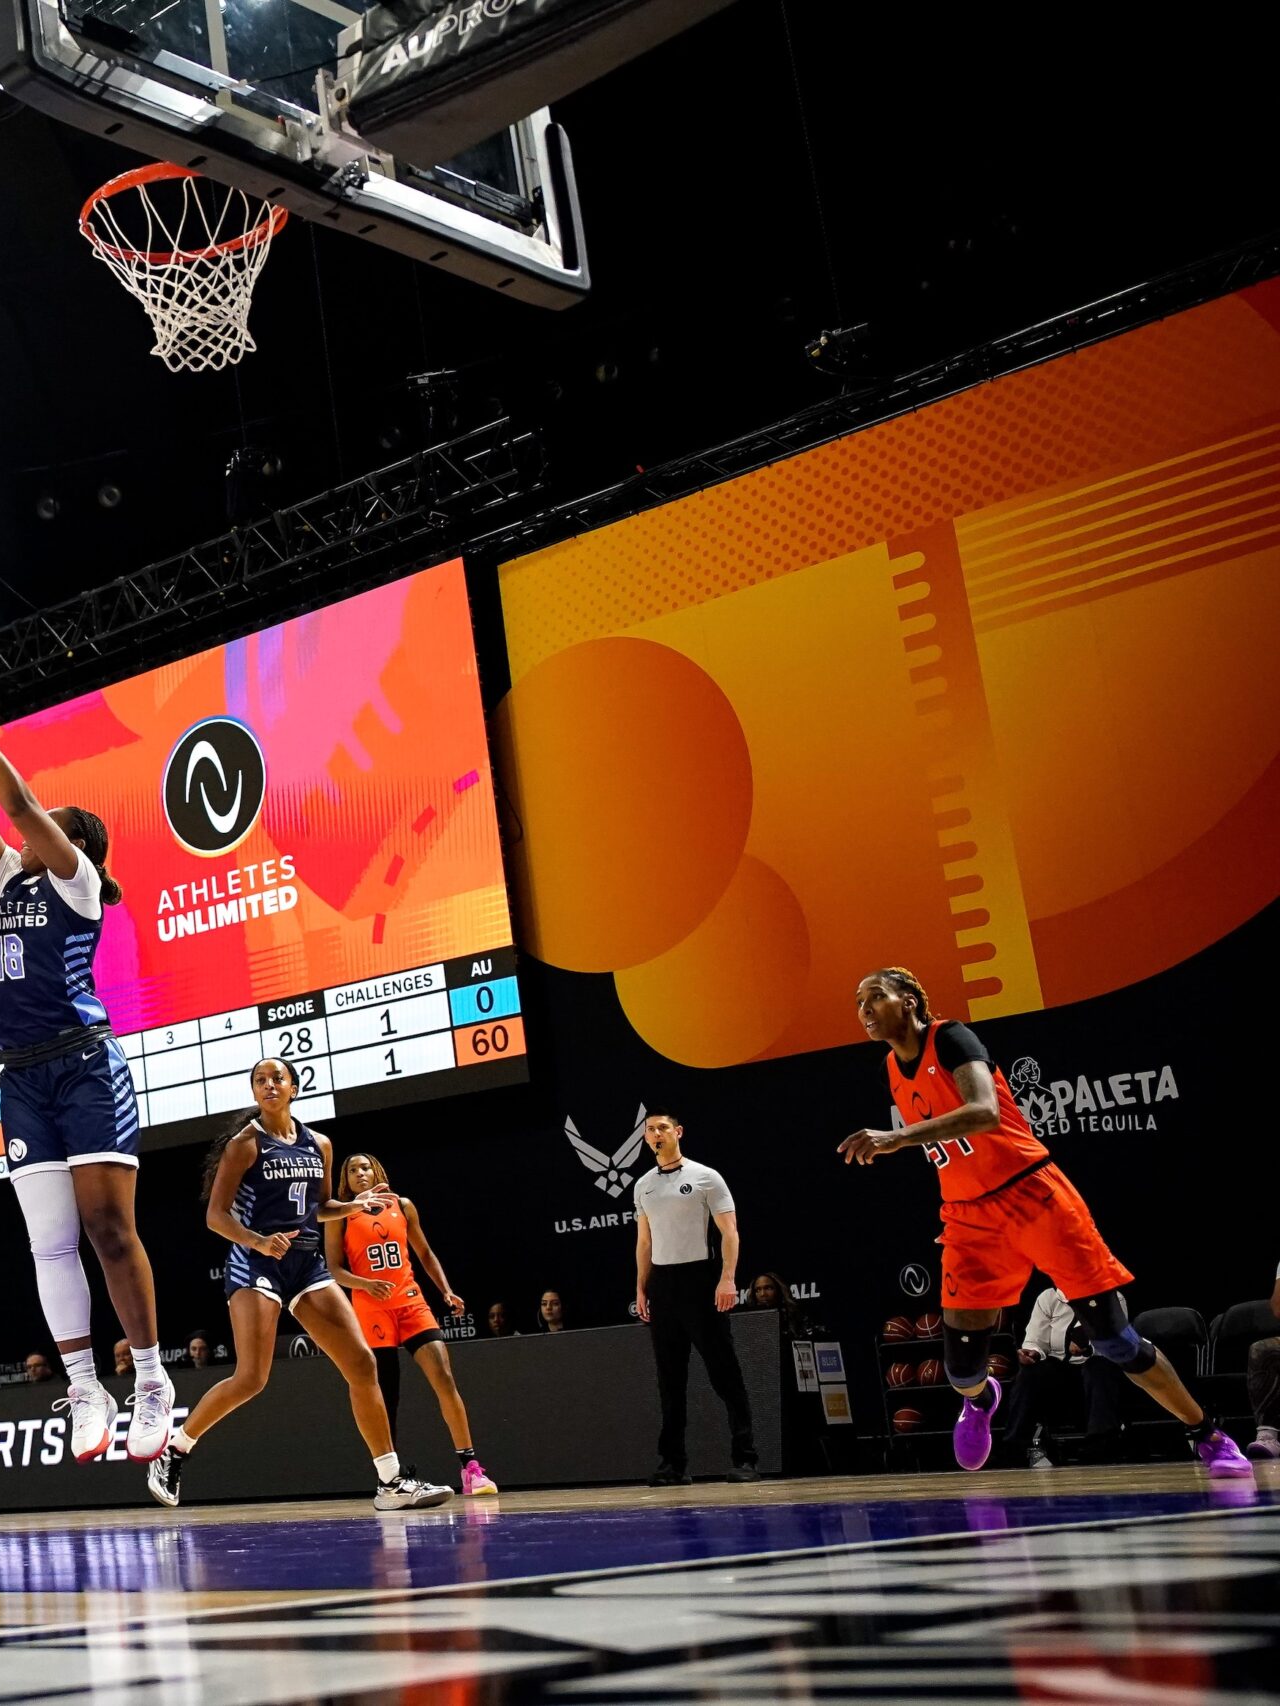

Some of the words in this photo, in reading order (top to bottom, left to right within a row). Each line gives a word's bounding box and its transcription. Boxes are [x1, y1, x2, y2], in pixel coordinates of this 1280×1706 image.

[380, 0, 523, 75] AUPRO
[157, 855, 297, 915] ATHLETES
[157, 885, 299, 942] UNLIMITED
[166, 1031, 174, 1045] 3
[224, 1017, 233, 1032] 4
[267, 999, 315, 1022] SCORE
[335, 972, 433, 1008] CHALLENGES
[471, 958, 493, 978] AU
[278, 1027, 313, 1058] 28
[380, 1009, 398, 1037] 1
[476, 985, 494, 1013] 0
[296, 1064, 317, 1093] 2
[384, 1048, 402, 1077] 1
[471, 1024, 509, 1057] 60
[1050, 1065, 1179, 1119] PALETA
[1078, 1114, 1158, 1133] TEQUILA
[262, 1156, 324, 1170] ATHLETES
[263, 1168, 324, 1180] UNLIMITED
[288, 1181, 308, 1215] 4
[554, 1218, 587, 1234] U.S.
[589, 1213, 619, 1229] AIR
[366, 1241, 402, 1272] 98
[439, 1313, 475, 1327] LETES
[440, 1326, 476, 1340] MITED
